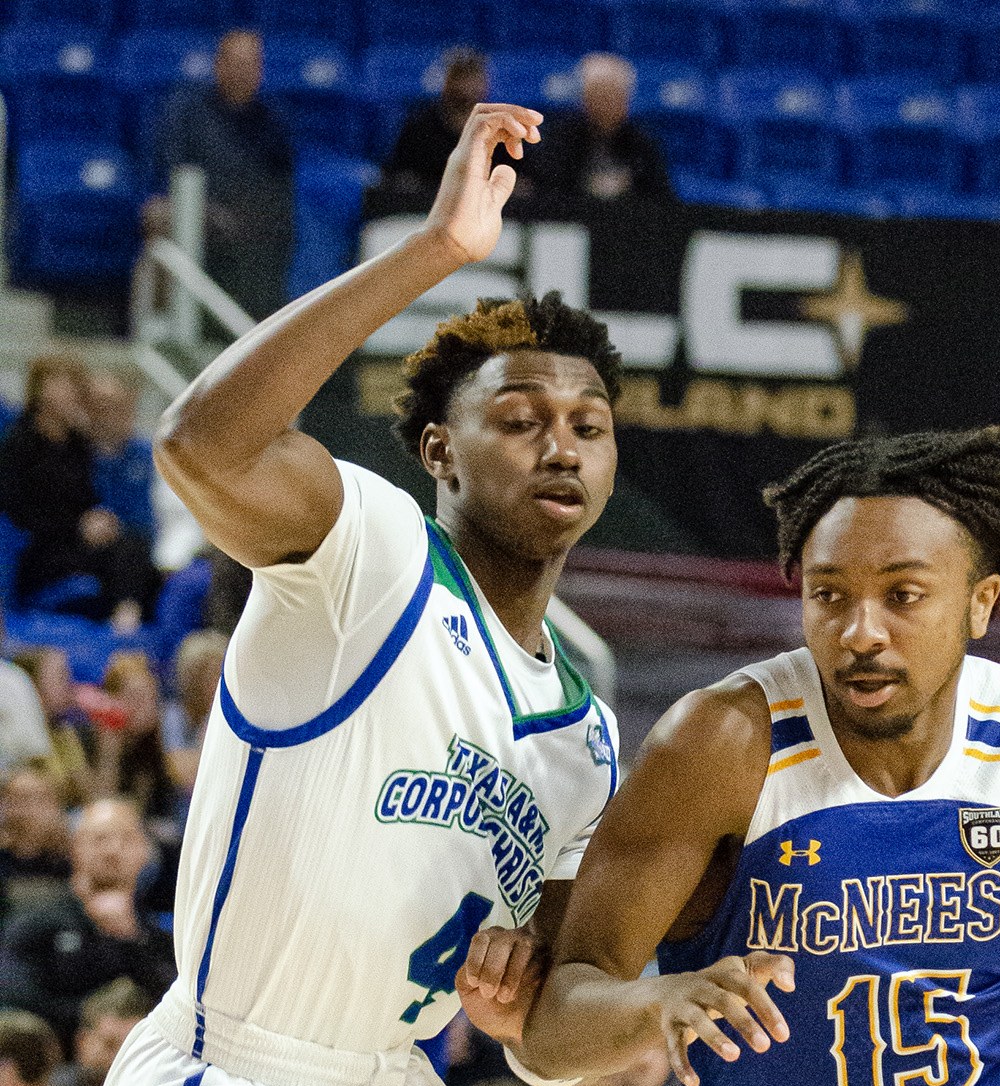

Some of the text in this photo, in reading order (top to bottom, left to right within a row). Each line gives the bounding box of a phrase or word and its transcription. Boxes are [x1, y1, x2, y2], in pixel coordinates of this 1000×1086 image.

[375, 769, 489, 838] CORPU
[447, 733, 517, 814] TXAS
[398, 890, 495, 1024] 4
